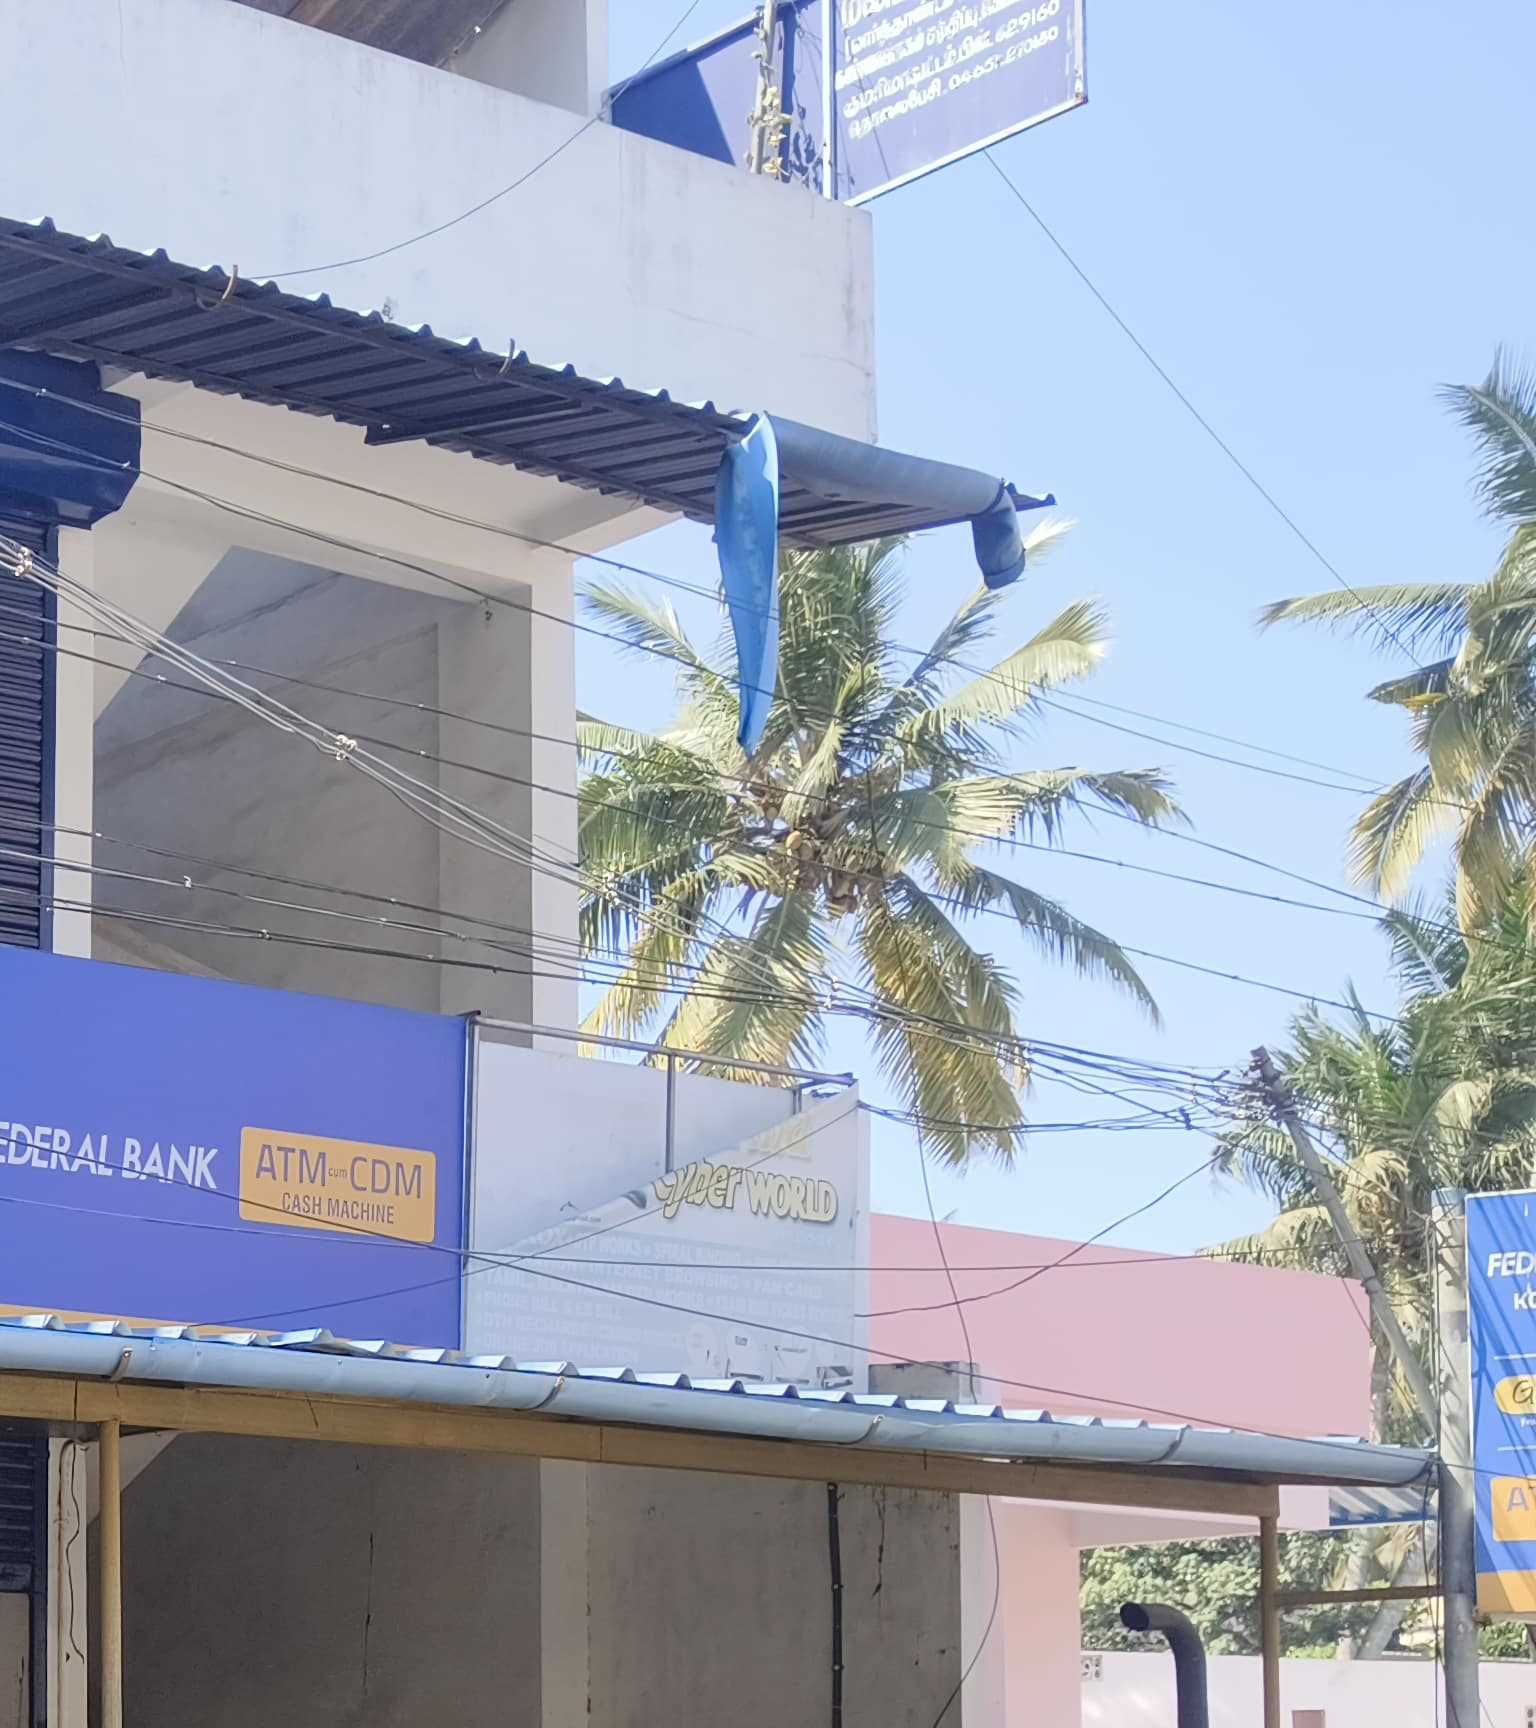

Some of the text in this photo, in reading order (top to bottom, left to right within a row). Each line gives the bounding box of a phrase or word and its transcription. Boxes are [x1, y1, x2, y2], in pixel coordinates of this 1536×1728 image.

[122, 1137, 219, 1189] BANK
[255, 1144, 327, 1187] ATM
[350, 1156, 423, 1200] CDM
[282, 1192, 395, 1225] CASH MACHINE
[745, 1168, 839, 1223] WORLD
